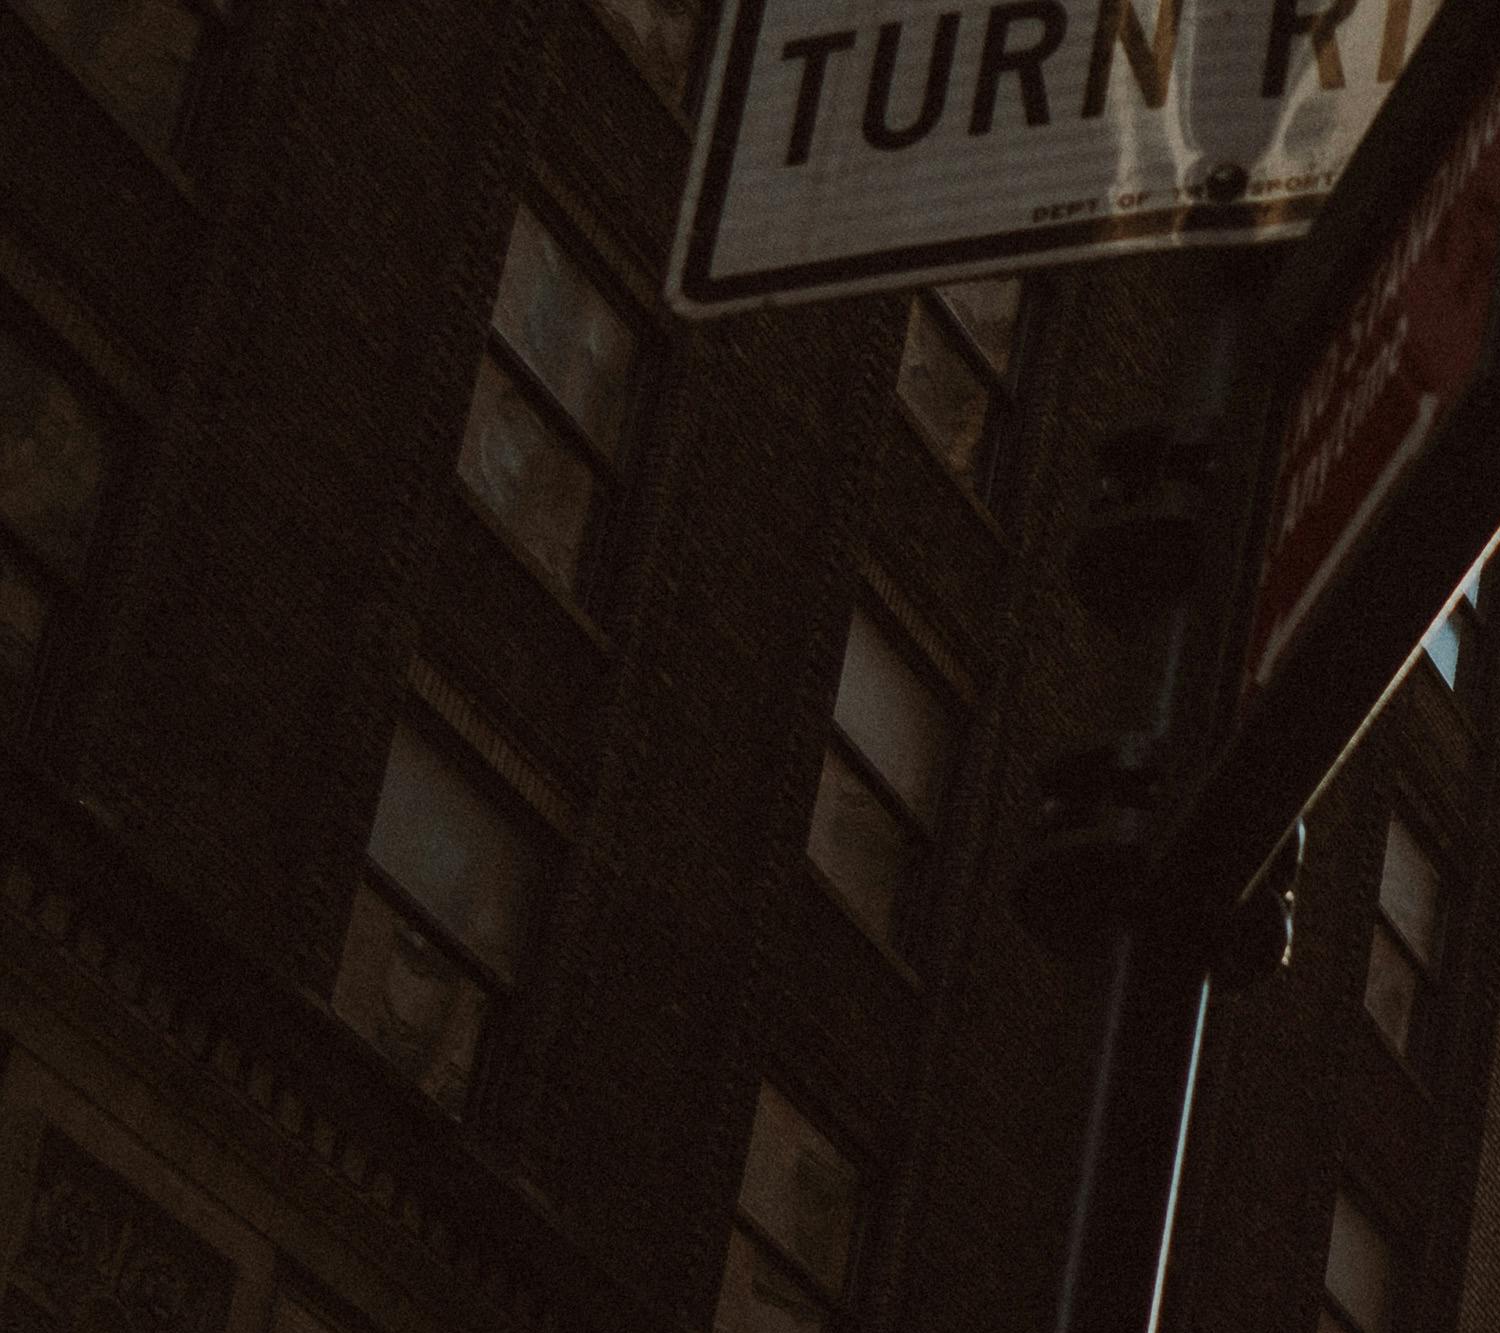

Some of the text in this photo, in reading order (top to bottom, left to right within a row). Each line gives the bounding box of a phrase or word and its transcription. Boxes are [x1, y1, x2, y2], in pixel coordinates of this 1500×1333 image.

[779, 0, 1184, 168] TURN
[1033, 198, 1098, 223] DEPT
[1116, 191, 1151, 210] OF
